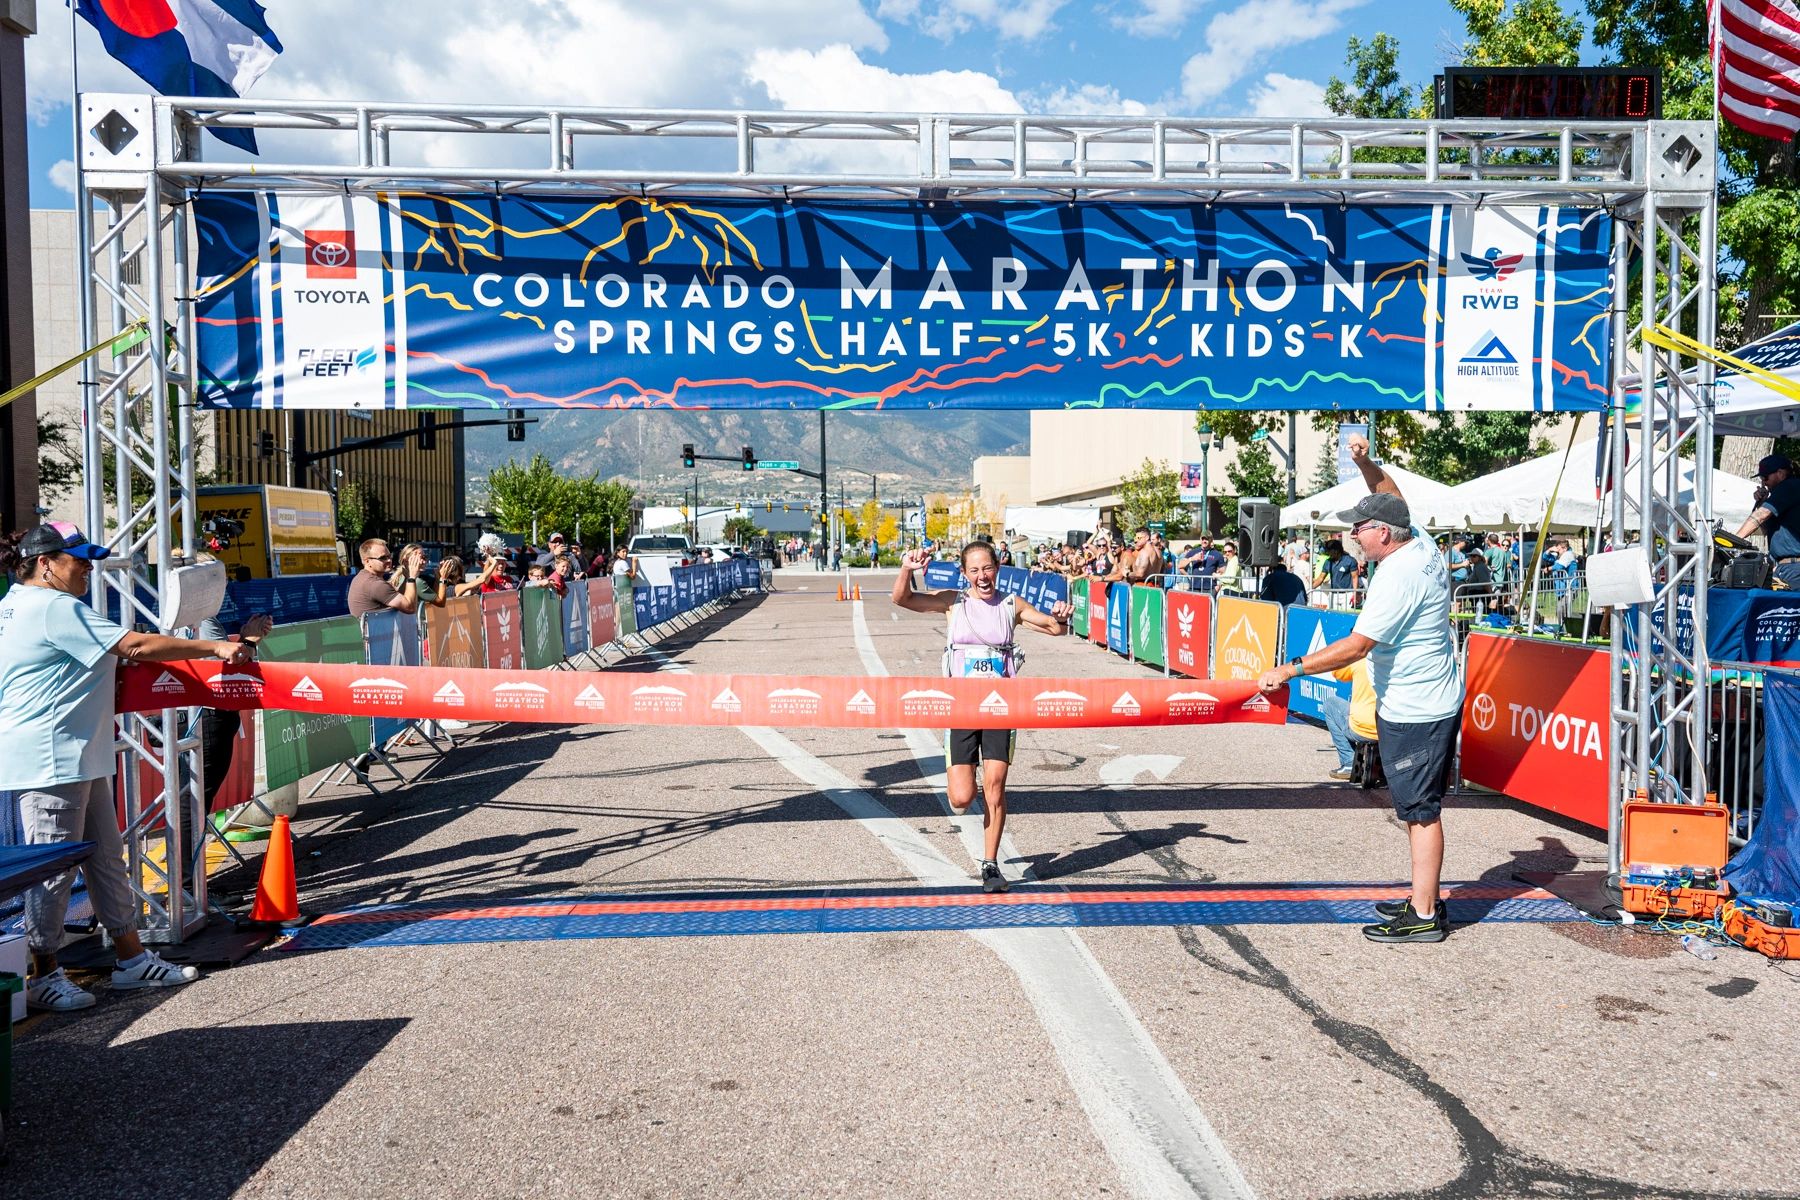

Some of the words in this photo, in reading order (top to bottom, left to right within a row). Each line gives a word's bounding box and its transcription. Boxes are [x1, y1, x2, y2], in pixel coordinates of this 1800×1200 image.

[472, 273, 795, 309] COLORADO
[840, 254, 1366, 313] MARATHON
[294, 290, 370, 304] TOYOTA
[1462, 295, 1519, 310] RWB
[553, 319, 796, 355] SPRINGS
[840, 321, 974, 357] HALF
[1053, 322, 1112, 357] 5K
[1191, 323, 1304, 358] KIDS
[1342, 324, 1363, 358] K
[298, 349, 358, 362] FLEET
[302, 363, 353, 377] FEET
[1457, 365, 1478, 376] HIGH
[1481, 365, 1520, 376] ALTITUDE
[1756, 626, 1800, 635] MARAT
[973, 660, 993, 672] 481
[1178, 648, 1194, 666] RWB
[1225, 648, 1261, 674] COLORADO
[1300, 679, 1312, 698] HIGH
[281, 717, 321, 744] COLORADO
[323, 714, 352, 730] SPRINGS
[1508, 702, 1602, 760] TOYOTA
